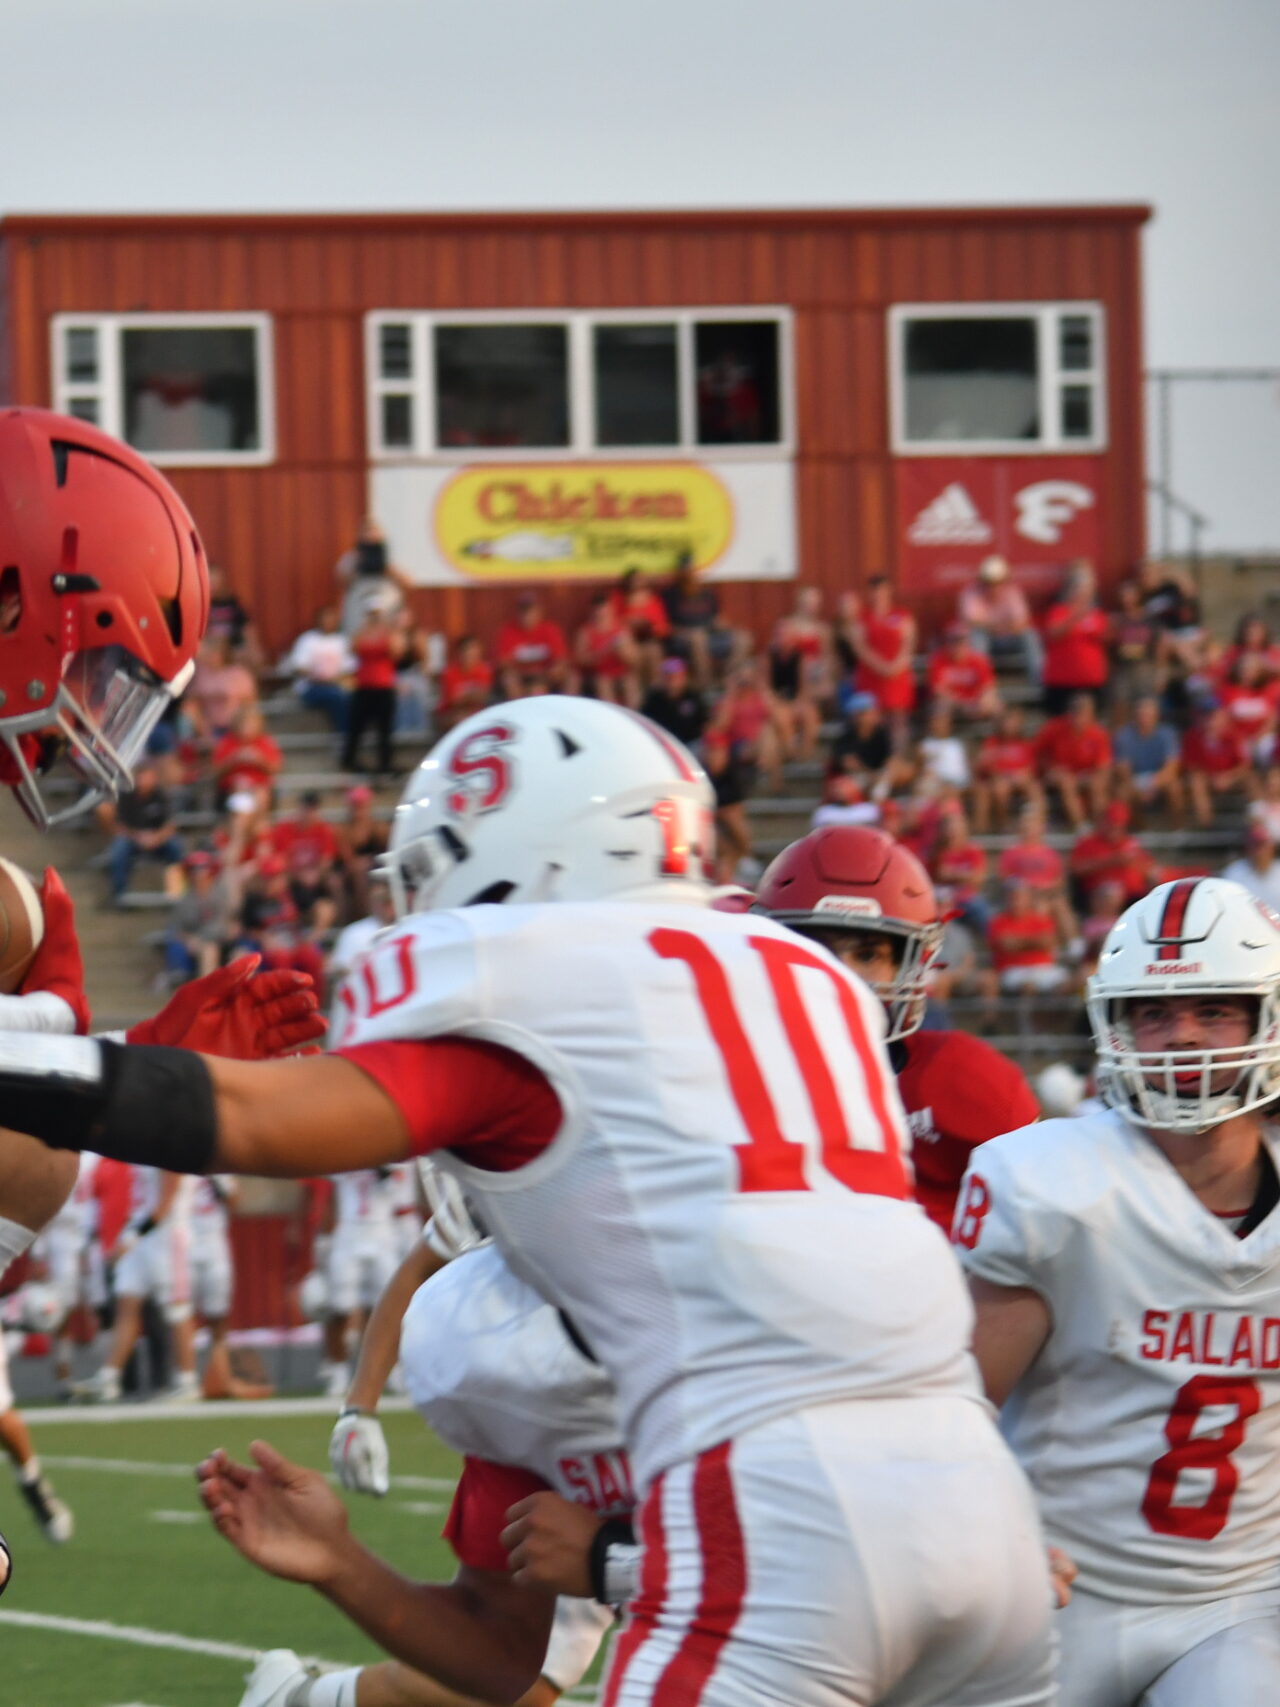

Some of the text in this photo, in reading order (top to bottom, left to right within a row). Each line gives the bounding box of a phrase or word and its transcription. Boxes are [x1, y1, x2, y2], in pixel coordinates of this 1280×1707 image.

[447, 725, 512, 813] S
[645, 926, 913, 1201] 10
[1141, 1309, 1280, 1369] SALAD
[1140, 1373, 1262, 1542] 8
